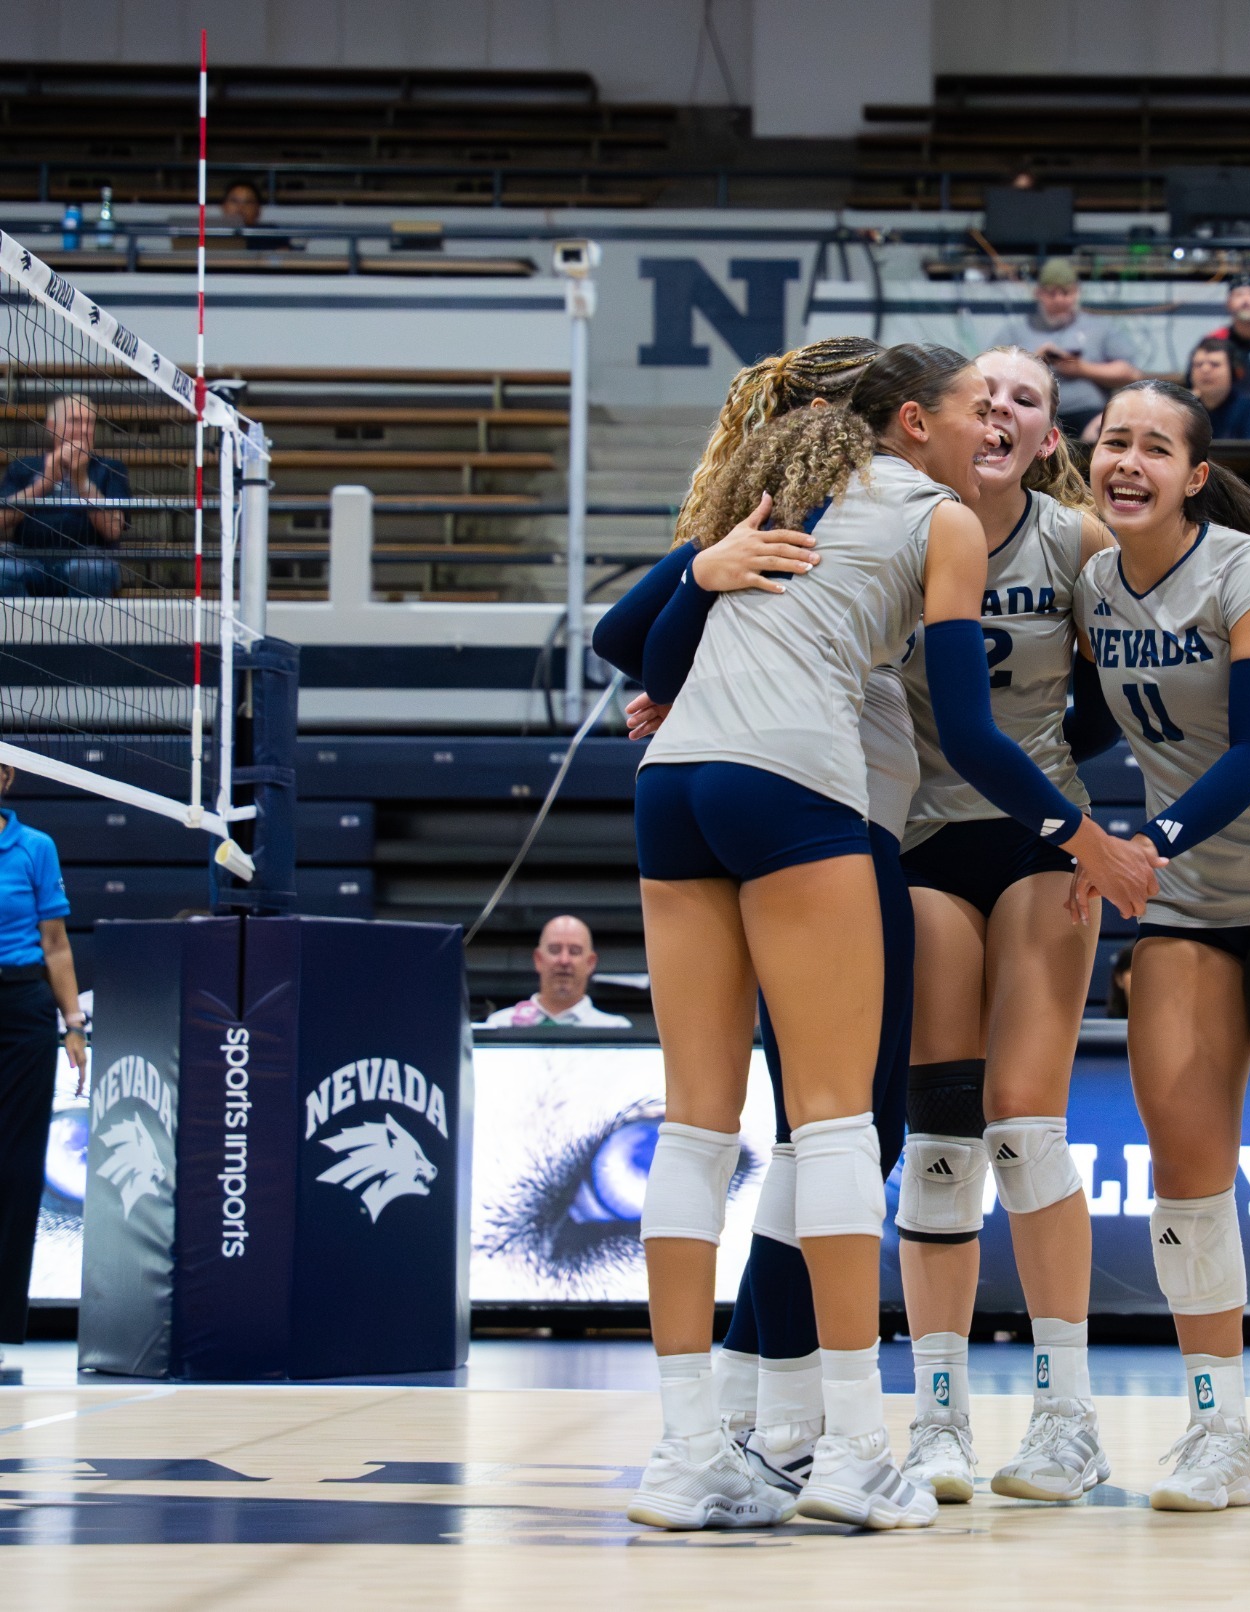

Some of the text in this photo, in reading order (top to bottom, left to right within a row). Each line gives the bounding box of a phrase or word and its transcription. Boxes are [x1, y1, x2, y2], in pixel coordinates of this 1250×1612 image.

[638, 258, 801, 366] N
[981, 586, 1058, 617] ADA
[1089, 625, 1214, 669] NEVADA
[1122, 683, 1185, 744] 11
[91, 1055, 173, 1139] NEVADA
[220, 1027, 252, 1129] sports
[305, 1057, 449, 1141] NEVADA
